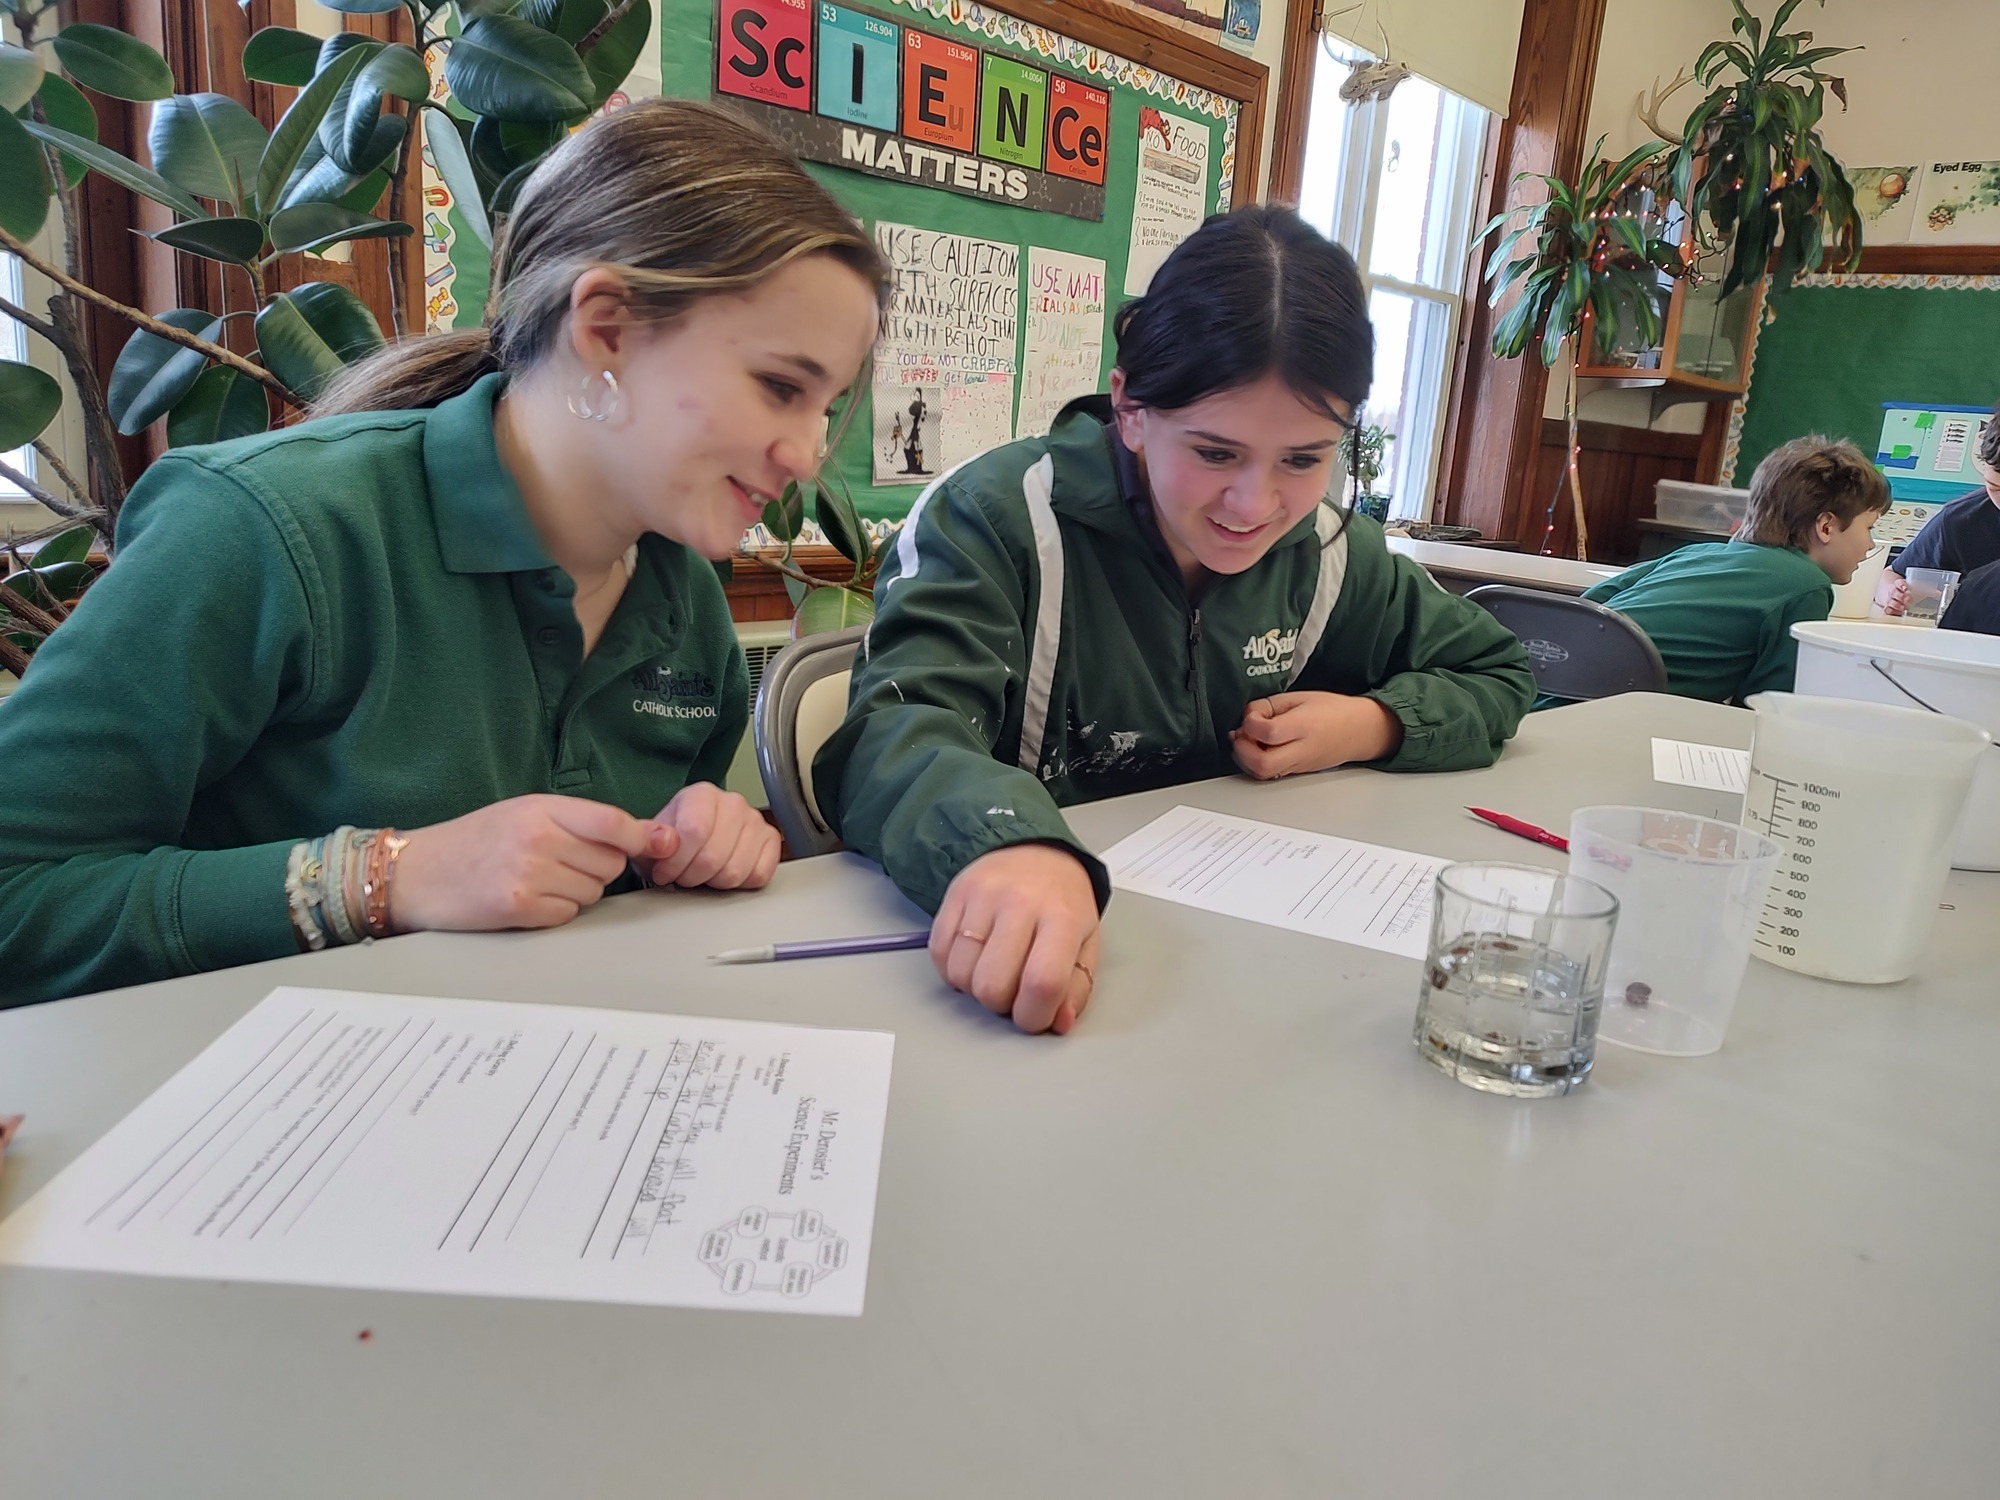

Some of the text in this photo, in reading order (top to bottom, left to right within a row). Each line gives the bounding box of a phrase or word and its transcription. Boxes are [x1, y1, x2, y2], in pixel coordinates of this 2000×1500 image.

[822, 5, 837, 22] 53
[865, 20, 893, 37] 126.904
[728, 8, 805, 89] Sc
[908, 33, 922, 49] 63
[947, 47, 973, 62] 151.964
[986, 57, 993, 70] 7
[851, 42, 865, 105] I
[749, 82, 788, 100] Scandium
[1055, 80, 1066, 94] 58
[847, 106, 868, 119] Iodine
[996, 86, 1029, 148] N
[924, 127, 954, 142] Europium
[1052, 106, 1102, 167] Ce
[1145, 125, 1207, 161] NO FOOD
[1000, 147, 1024, 160] Nitrogen
[841, 127, 1029, 201] MATTERS
[1069, 165, 1088, 176] Cerium
[1933, 162, 1982, 174] Eyed Egg
[879, 226, 1019, 279] USE CAUTION
[1032, 262, 1063, 295] USE
[949, 277, 1018, 318] SURFACES
[1029, 294, 1067, 315] ERIALS
[1069, 302, 1081, 315] AS
[991, 318, 1016, 340] THAT
[945, 326, 963, 347] BE
[964, 332, 1001, 358] HOT
[895, 348, 918, 365] YOU
[938, 354, 958, 366] NOT
[944, 371, 961, 387] get
[633, 700, 717, 719] CATHOLIC SCHOOL
[1803, 782, 1841, 799] 1000ml
[1801, 801, 1821, 813] 900
[1798, 818, 1818, 830] 800
[1796, 836, 1816, 848] 700
[1793, 852, 1812, 865] 600
[1789, 871, 1810, 883] 500
[1786, 888, 1806, 900] 400
[1783, 906, 1803, 919] 300
[1779, 926, 1800, 938] 200
[1777, 944, 1796, 957] 100
[793, 1096, 816, 1131] Science
[810, 1110, 839, 1180] Mr. Derosier's
[778, 1132, 809, 1195] Experiments
